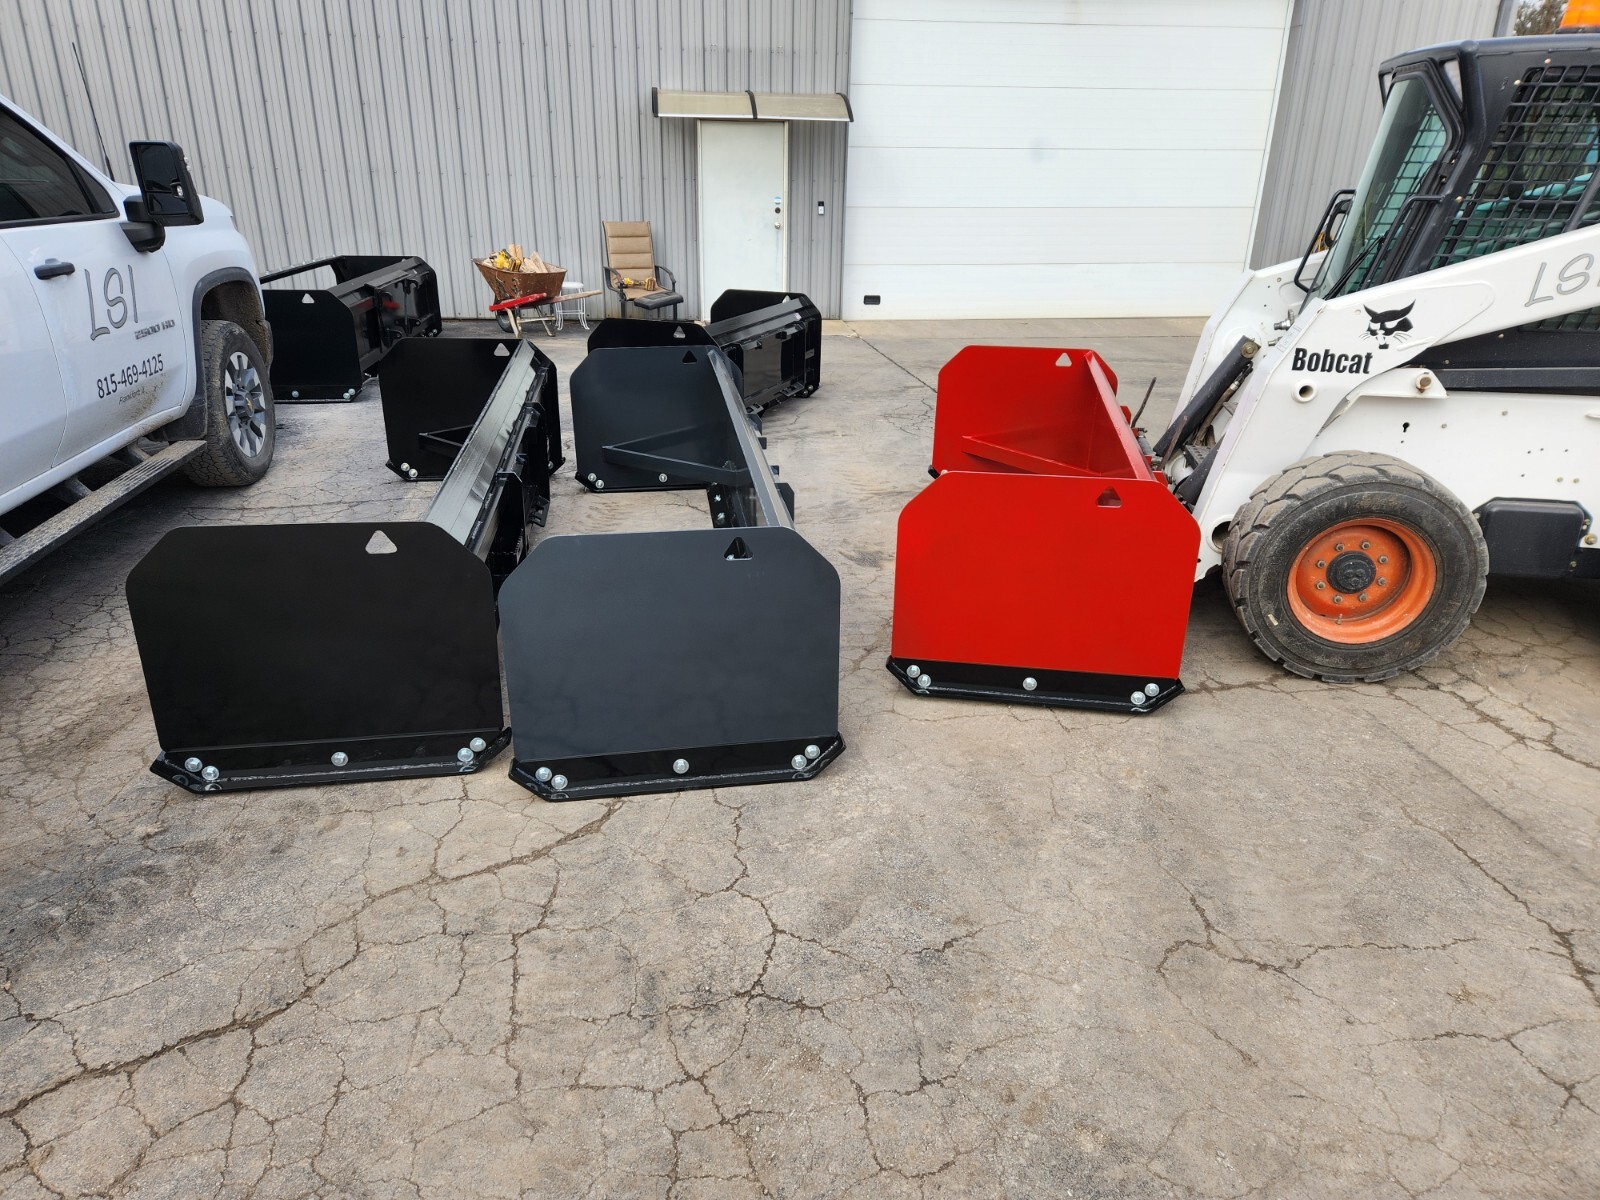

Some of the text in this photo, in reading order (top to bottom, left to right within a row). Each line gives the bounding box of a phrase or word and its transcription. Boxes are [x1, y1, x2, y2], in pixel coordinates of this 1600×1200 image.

[84, 264, 138, 341] LSI
[1524, 253, 1600, 307] LS
[97, 353, 164, 398] 815-469-4125
[1292, 347, 1373, 374] Bobcat
